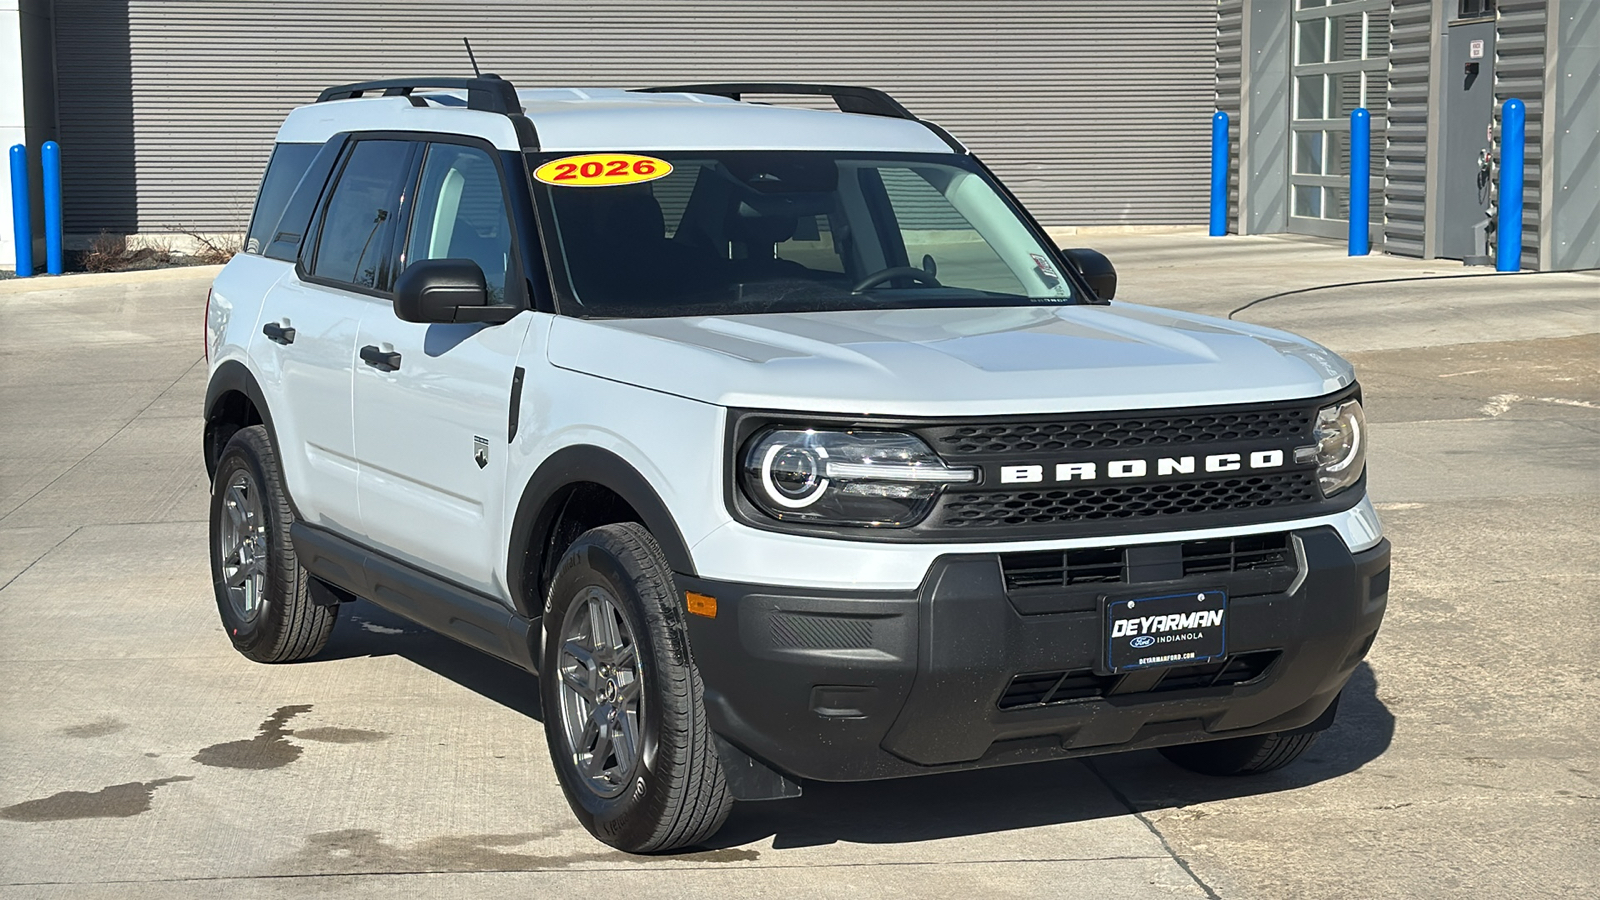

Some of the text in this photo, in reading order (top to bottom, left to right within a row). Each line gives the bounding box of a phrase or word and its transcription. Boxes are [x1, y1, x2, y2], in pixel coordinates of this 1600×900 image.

[552, 160, 656, 181] 2026
[1000, 449, 1284, 484] BRONCO
[1157, 632, 1204, 643] INDIANOLA
[1139, 652, 1195, 665] DEYARMANFORD.COM
